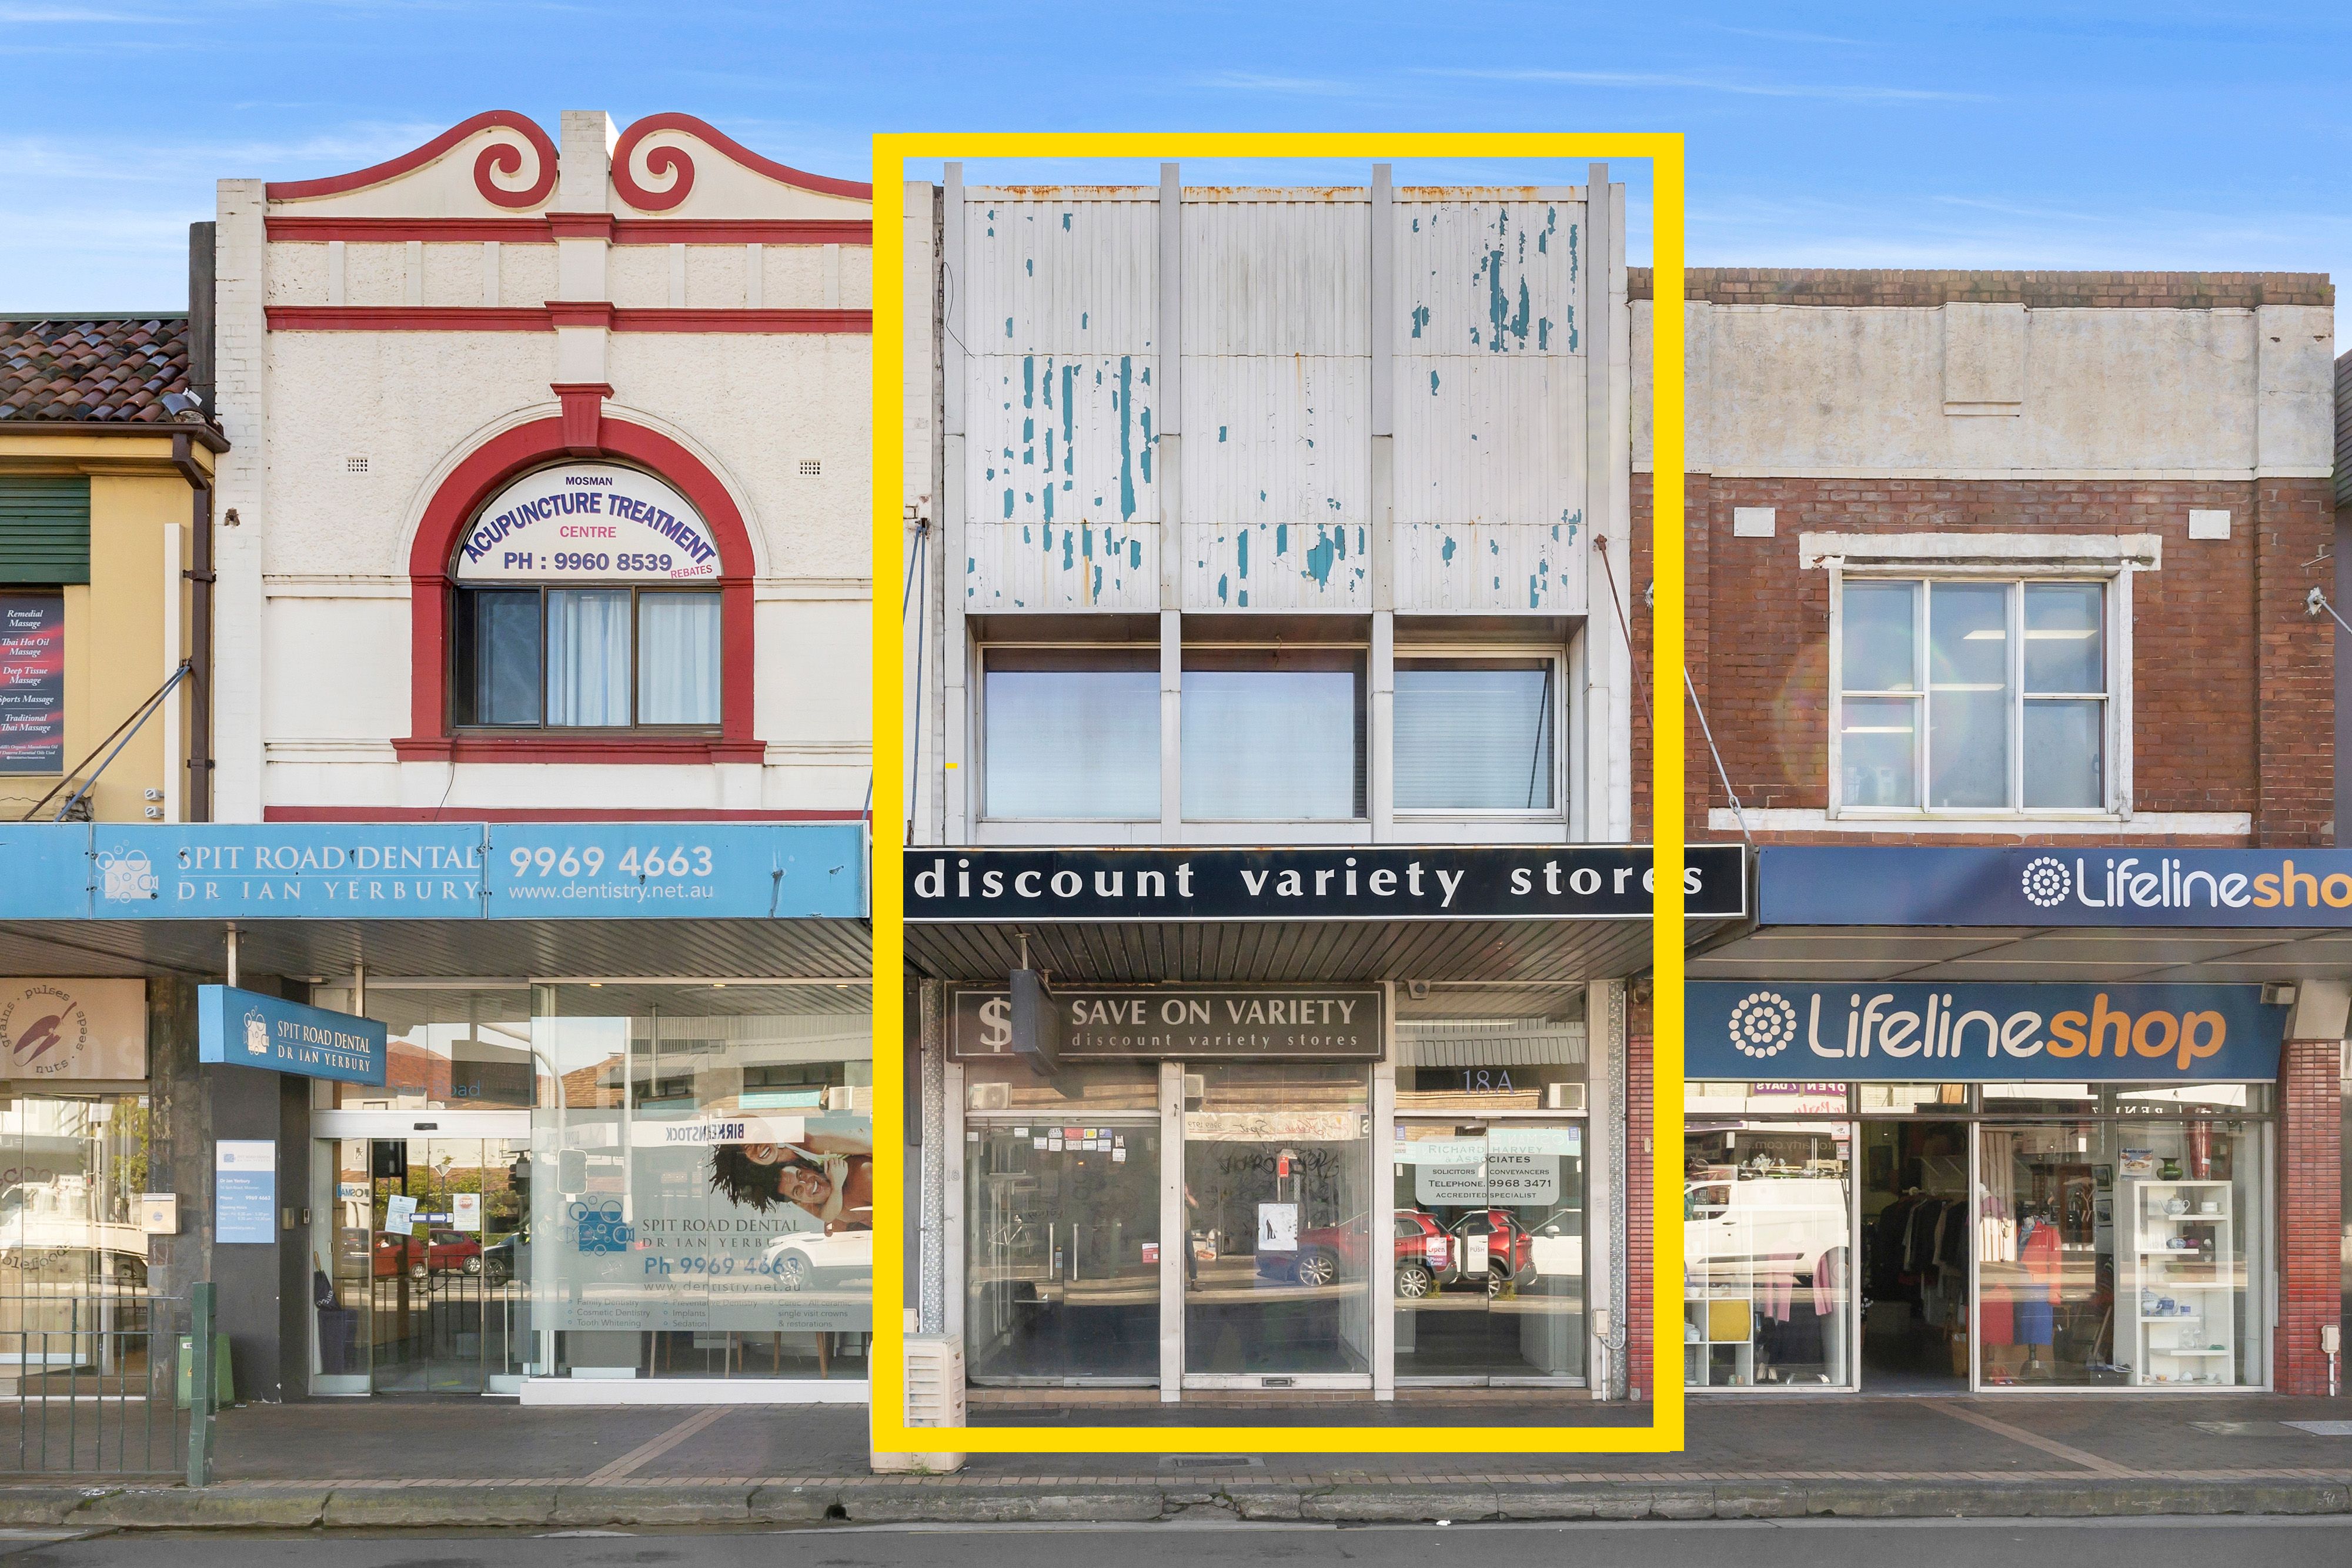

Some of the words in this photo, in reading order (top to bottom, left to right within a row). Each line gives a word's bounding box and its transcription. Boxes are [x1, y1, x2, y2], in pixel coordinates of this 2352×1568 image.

[565, 476, 613, 486] MOSMAN
[463, 492, 603, 564] ACUPUNCTURE
[608, 494, 716, 564] TREATMENT
[559, 526, 617, 538] CENTRE
[504, 552, 532, 570] PH
[554, 553, 609, 571] 9960
[616, 553, 672, 571] 8539
[670, 564, 713, 579] REBATES
[9, 619, 41, 629] Massage
[9, 648, 41, 658] Massage
[3, 667, 22, 677] Deep
[9, 676, 41, 686] Massage
[22, 695, 54, 705] Massage
[19, 723, 51, 734] Massage
[178, 846, 244, 870] SPIT
[254, 846, 346, 870] ROAD
[357, 846, 480, 870] DENTAL
[510, 847, 604, 877] 9969
[619, 846, 713, 877] 4663
[914, 858, 1194, 898] discount
[1240, 857, 1465, 908] variety
[178, 881, 221, 900] DR
[242, 881, 301, 900] IAN
[325, 881, 481, 900] YERBURY
[509, 881, 713, 903] www.dentistry.net.au
[24, 985, 70, 1001] pulses
[1072, 999, 1146, 1025] SAVE
[1161, 999, 1210, 1025] ON
[1225, 999, 1357, 1025] VARIETY
[0, 1002, 15, 1048] grains
[76, 1010, 88, 1051] seeds
[278, 1020, 300, 1040] SPIT
[303, 1025, 332, 1046] ROAD
[334, 1032, 370, 1054] DENTAL
[1072, 1033, 1171, 1046] discount
[1189, 1033, 1270, 1049] variety
[1288, 1034, 1357, 1046] stores
[278, 1045, 293, 1059] DR
[299, 1048, 319, 1064] IAN
[325, 1053, 370, 1072] YERBURY
[36, 1059, 69, 1074] nuts
[1462, 1069, 1515, 1095] 18A
[642, 1219, 677, 1232] SPIT
[682, 1219, 730, 1232] ROAD
[736, 1219, 800, 1232] DENTAL
[643, 1238, 666, 1247] DR
[677, 1238, 707, 1247] IAN
[719, 1238, 777, 1247] YERBU
[644, 1256, 670, 1274] Ph
[680, 1257, 734, 1275] 9969
[644, 1281, 801, 1292] www.dentistry.net.au
[577, 1298, 602, 1307] Family
[604, 1298, 639, 1307] Dentistry
[723, 1299, 758, 1308] Dentistry
[577, 1308, 613, 1316] Cosmetic
[616, 1308, 650, 1318] Dentistry
[673, 1309, 706, 1319] Implants
[778, 1309, 801, 1319] single
[601, 1319, 642, 1328] Whitening
